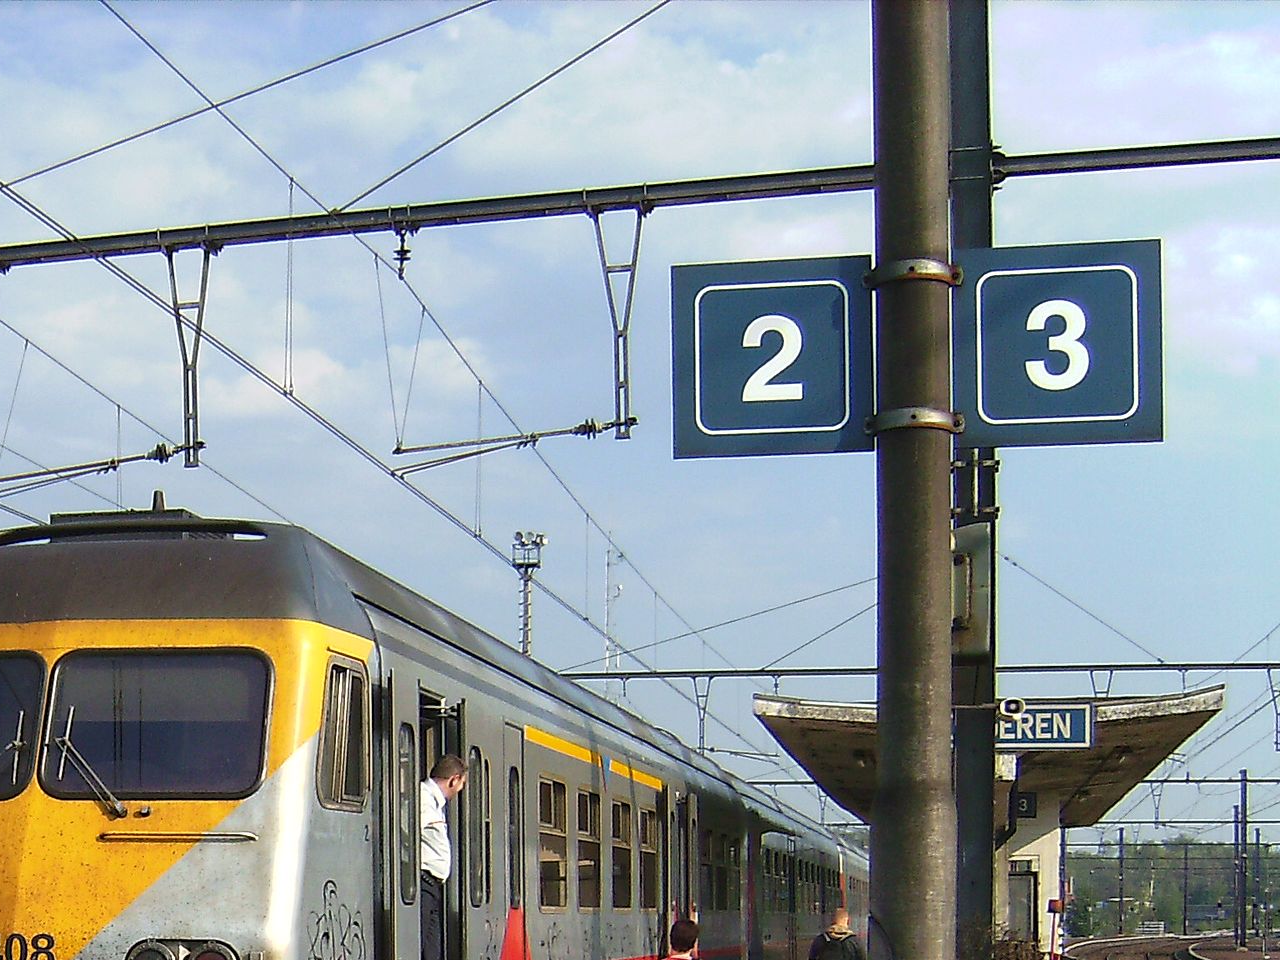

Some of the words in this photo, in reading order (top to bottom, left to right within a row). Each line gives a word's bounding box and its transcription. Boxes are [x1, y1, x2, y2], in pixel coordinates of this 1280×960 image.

[742, 314, 804, 403] 2
[1024, 299, 1091, 392] 3
[995, 713, 1071, 740] EREN
